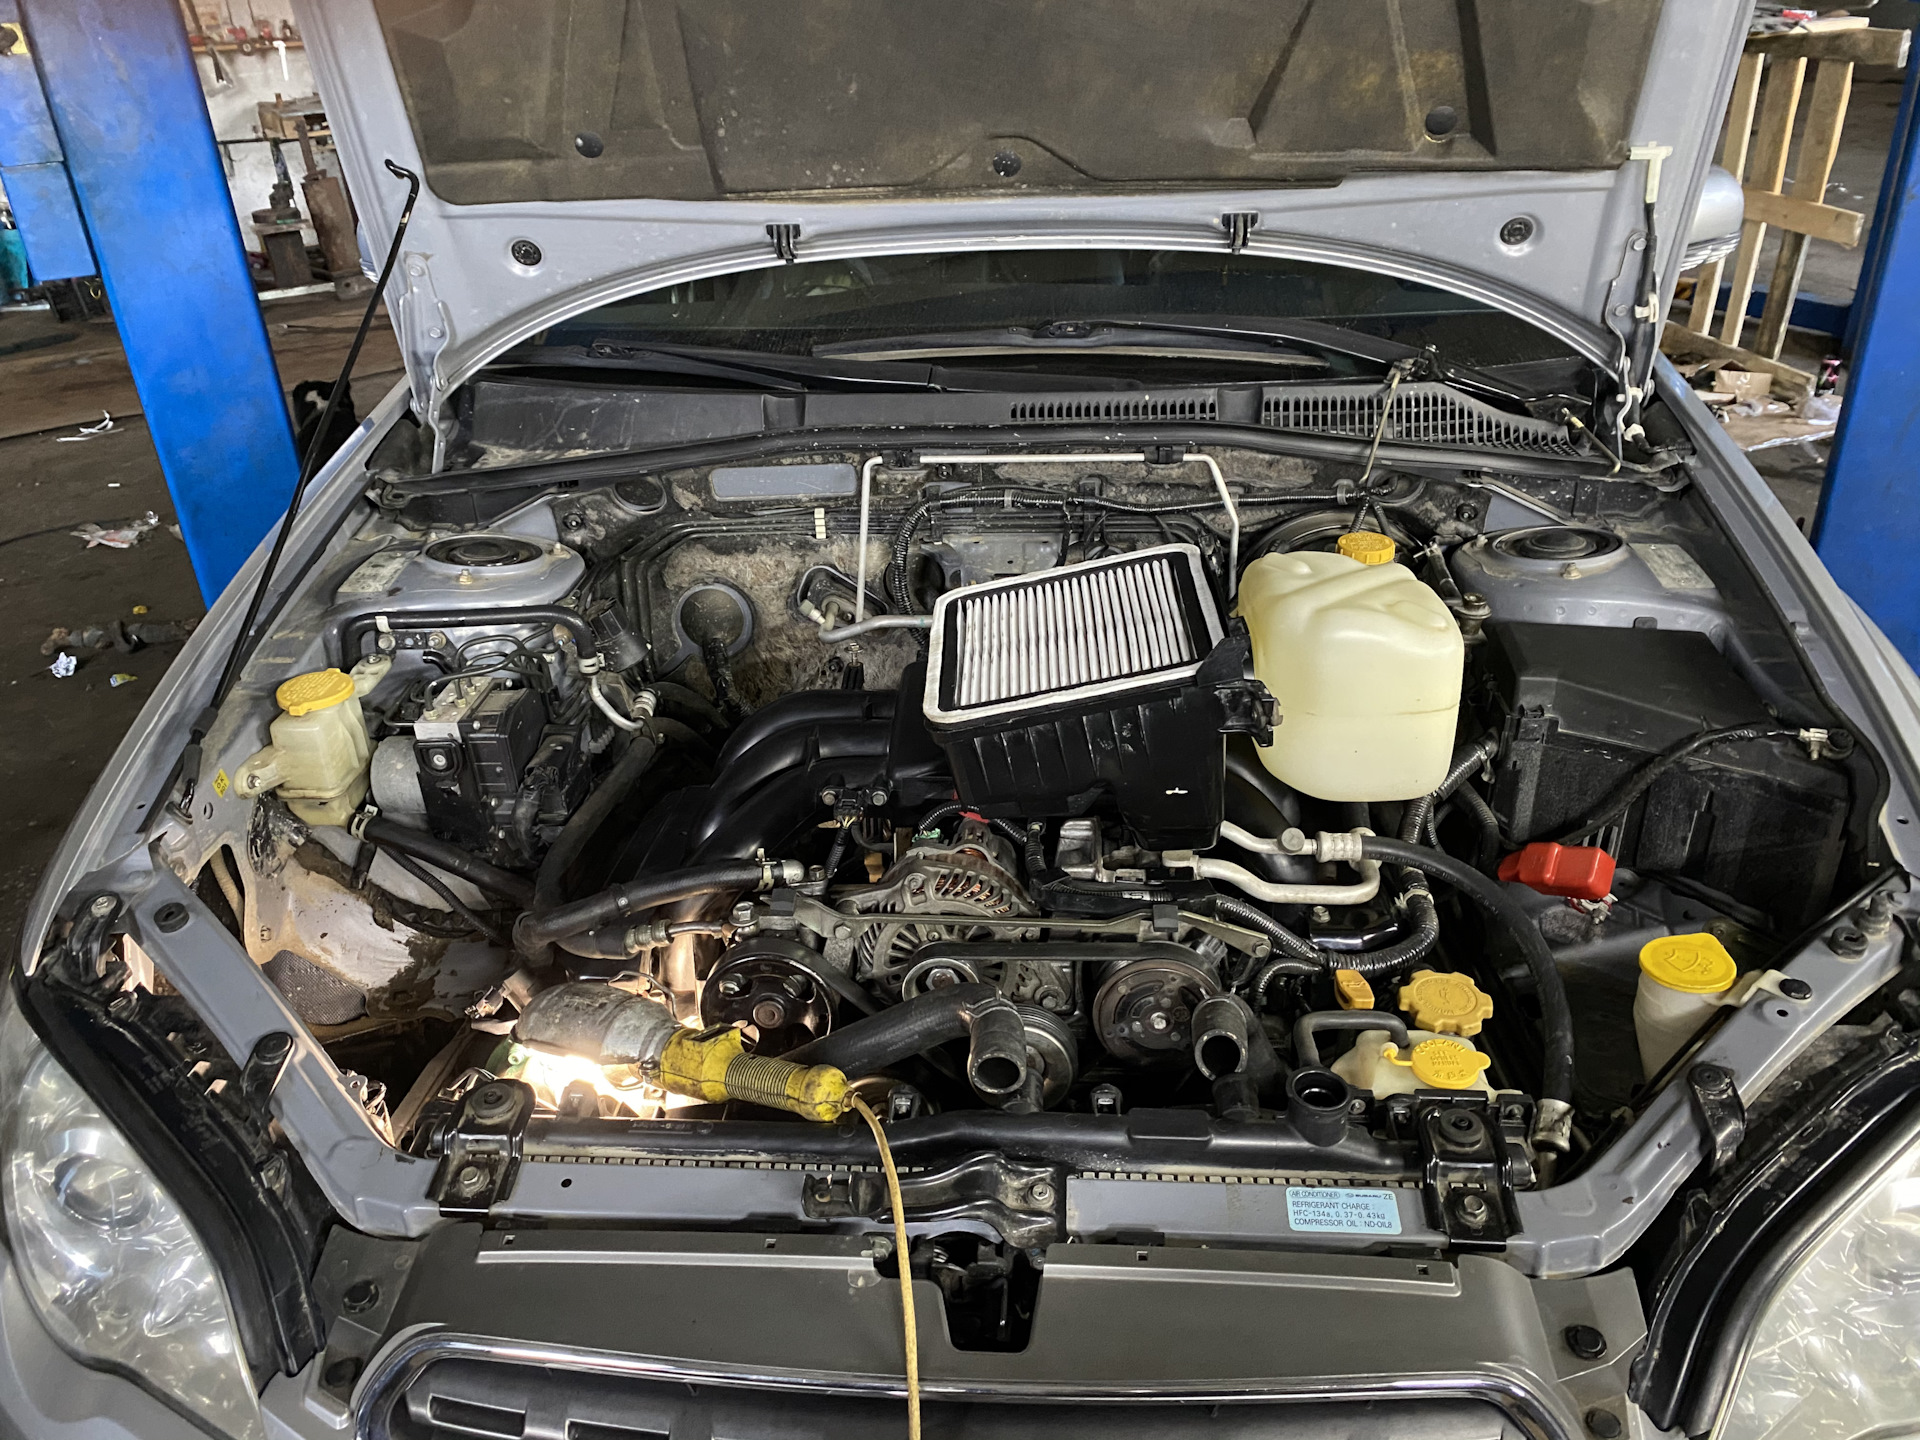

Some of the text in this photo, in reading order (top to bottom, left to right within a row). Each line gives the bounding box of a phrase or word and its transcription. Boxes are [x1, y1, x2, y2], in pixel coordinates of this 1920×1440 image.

[1383, 1193, 1394, 1201] ZE
[1292, 1200, 1340, 1209] REFRIGERANT
[1294, 1218, 1344, 1227] COMPRESSOR
[1364, 1220, 1393, 1229] ND-OIL8
